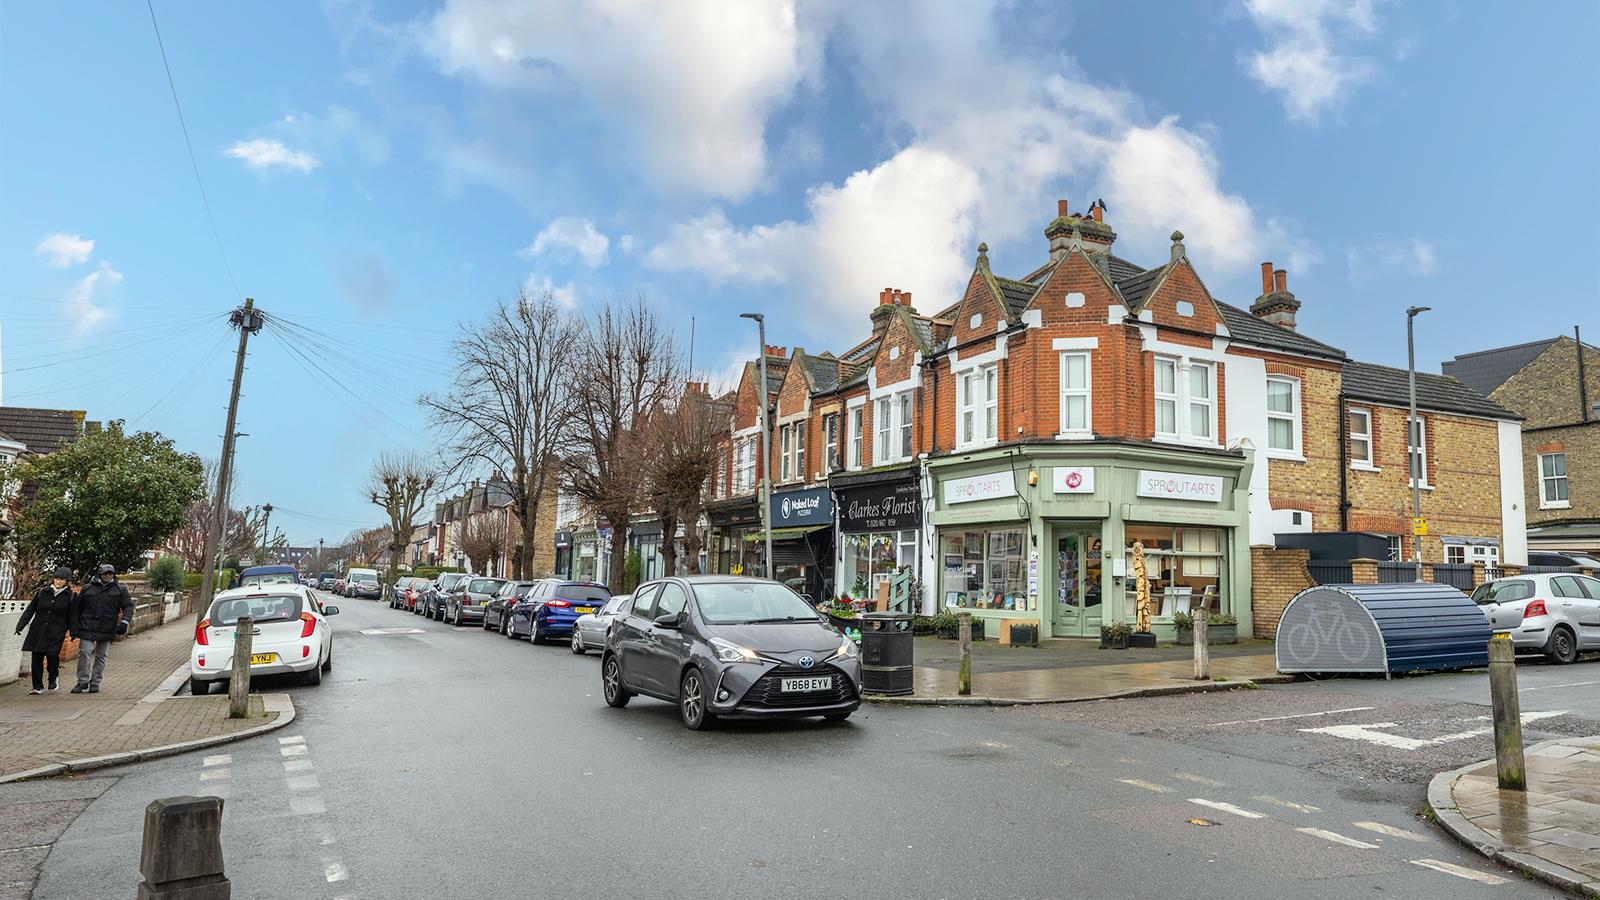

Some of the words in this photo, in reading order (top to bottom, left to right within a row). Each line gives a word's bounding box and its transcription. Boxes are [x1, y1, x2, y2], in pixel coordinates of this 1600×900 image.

[1147, 478, 1216, 496] SPROUTARTS
[791, 498, 807, 510] Naked
[807, 496, 820, 508] Loaf
[848, 499, 880, 520] Clarkes
[881, 496, 917, 517] Florist
[256, 654, 272, 662] YNJ
[786, 680, 810, 691] YB68
[811, 679, 829, 689] EYV
